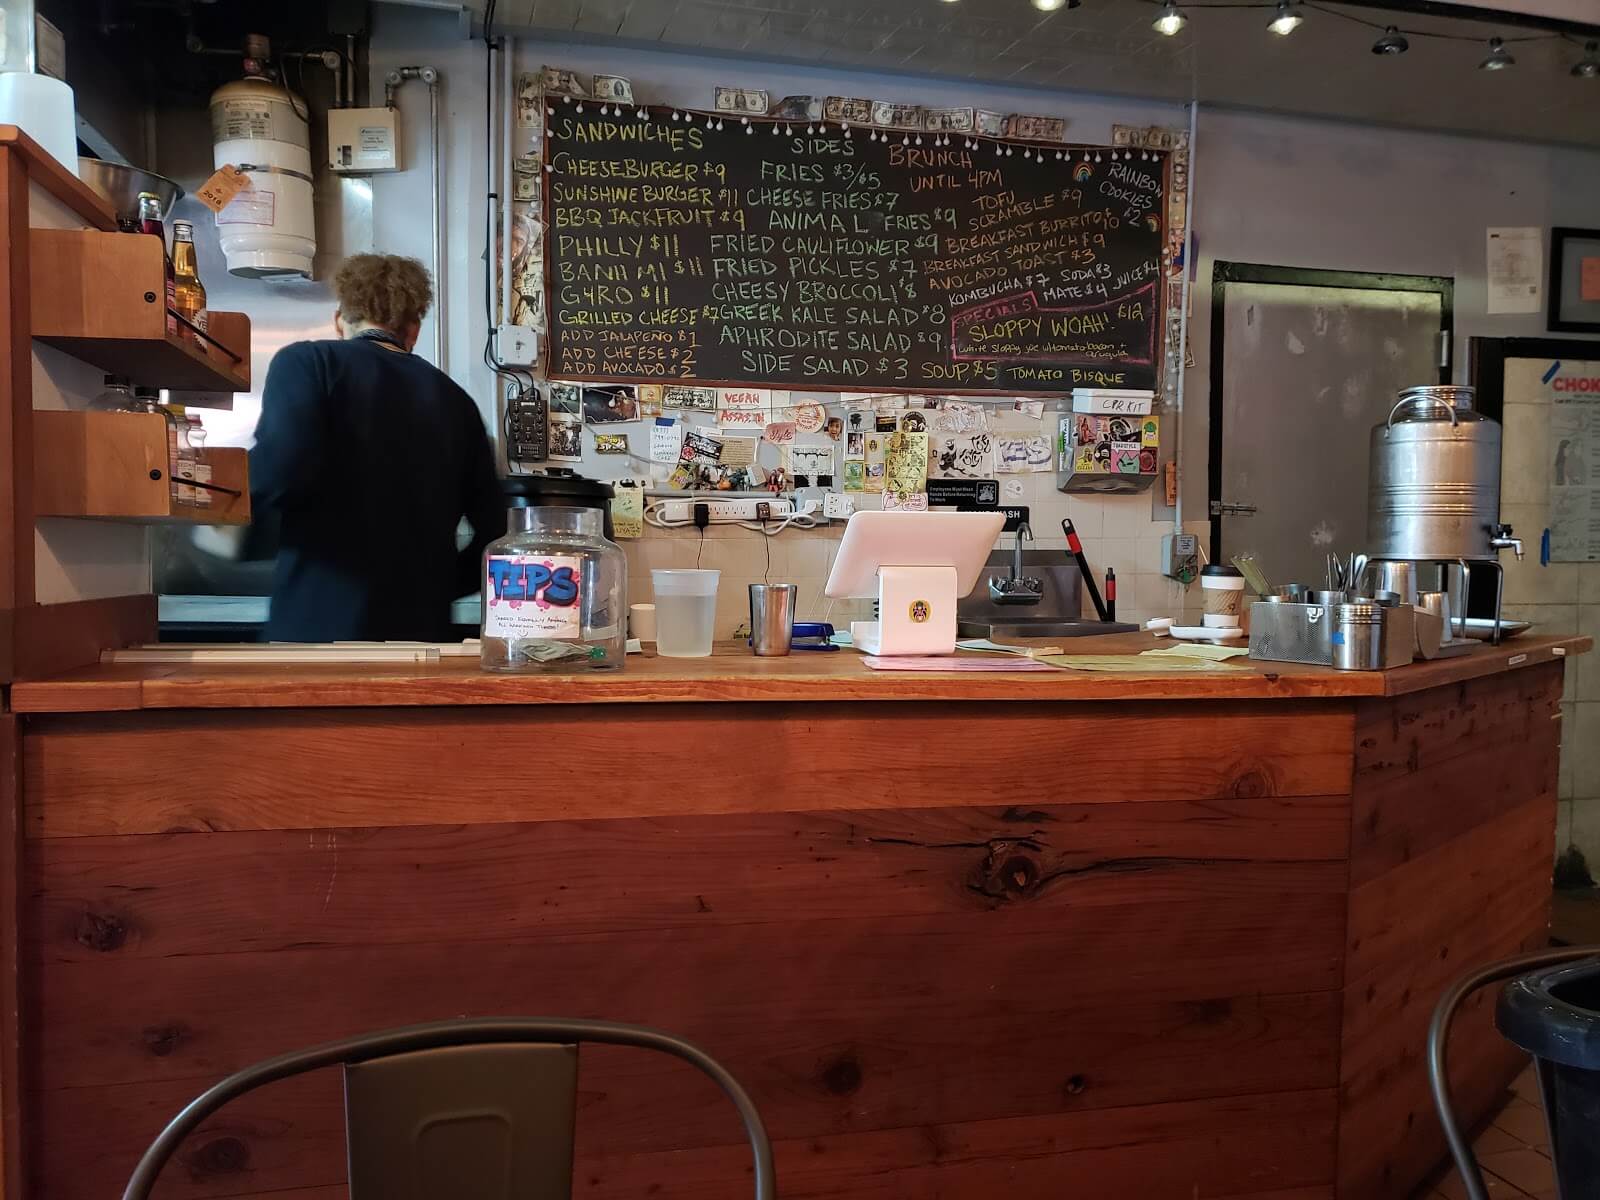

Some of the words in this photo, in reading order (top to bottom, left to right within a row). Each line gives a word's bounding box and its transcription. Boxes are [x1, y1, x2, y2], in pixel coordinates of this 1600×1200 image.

[556, 118, 704, 152] SANDWICHES
[790, 137, 855, 156] SIDES
[552, 152, 699, 183] CHEESEBURGER
[703, 160, 726, 185] $9
[888, 143, 973, 169] BRUNCH
[760, 160, 825, 183] FRIES
[910, 175, 961, 192] UNTIL
[968, 168, 1003, 189] 4PM
[553, 182, 639, 204] SUNSHINE
[642, 184, 715, 206] BURGER
[718, 188, 738, 207] $11
[746, 188, 813, 209] CHEESE
[822, 191, 871, 210] FRIES
[874, 192, 900, 212] $7
[972, 190, 1015, 211] TOFU
[1099, 181, 1153, 209] COOKIES
[555, 207, 603, 228] BBQ
[607, 207, 716, 228] JACKFRUIT
[720, 208, 745, 231] $9
[768, 209, 869, 234] ANIMAL
[884, 213, 932, 232] FRIES
[934, 207, 957, 229] $9
[968, 193, 1055, 232] SCRAMBLE
[710, 234, 776, 254] FRIED
[782, 235, 910, 257] CAULIFLOWER
[914, 233, 939, 255] $9
[945, 221, 1035, 255] BREAKFAST
[1040, 211, 1102, 236] BURRITO
[558, 233, 643, 259] PHILLY
[650, 233, 680, 257] $11
[923, 249, 1001, 276] BREAKFAST
[1004, 233, 1078, 260] SANDWICH
[558, 261, 629, 282] BANH
[637, 261, 668, 282] MI
[674, 256, 704, 276] $11
[712, 257, 778, 280] FRIED
[788, 256, 881, 280] PICKLES
[887, 258, 918, 280] $7
[929, 264, 1008, 291] AVOCADO
[1011, 250, 1068, 271] TOAST
[1060, 268, 1096, 283] SODA
[1112, 268, 1144, 291] JUICE
[640, 284, 670, 305] $11
[712, 279, 791, 303] CHEESY
[797, 279, 900, 304] BROCCOLI
[949, 277, 1023, 308] KOMBUCHA
[1043, 284, 1084, 303] MATE
[558, 308, 633, 326] GRILLED
[638, 307, 698, 326] CHEESE
[720, 302, 784, 322] GREEK
[791, 305, 838, 325] KALE
[845, 306, 919, 327] SALAD
[921, 303, 946, 325] $8
[561, 330, 595, 343] ADD
[718, 324, 840, 350] APHRODITE
[847, 331, 912, 354] SALAD
[968, 315, 1042, 344] SLOPPY
[562, 347, 597, 360] ADD
[604, 345, 667, 360] CHEESE
[670, 347, 697, 364] $2
[741, 350, 796, 375] SIDE
[803, 354, 870, 378] SALAD
[876, 357, 909, 380] $3
[562, 361, 596, 375] ADD
[602, 360, 665, 376] AVOCADO
[973, 359, 998, 381] $5
[1006, 366, 1063, 381] TOMATO
[1072, 368, 1126, 384] BISQUE
[724, 391, 760, 404] VEGAN
[1102, 399, 1124, 411] CPR
[1126, 400, 1145, 412] KIT
[488, 559, 579, 607] TIPS
